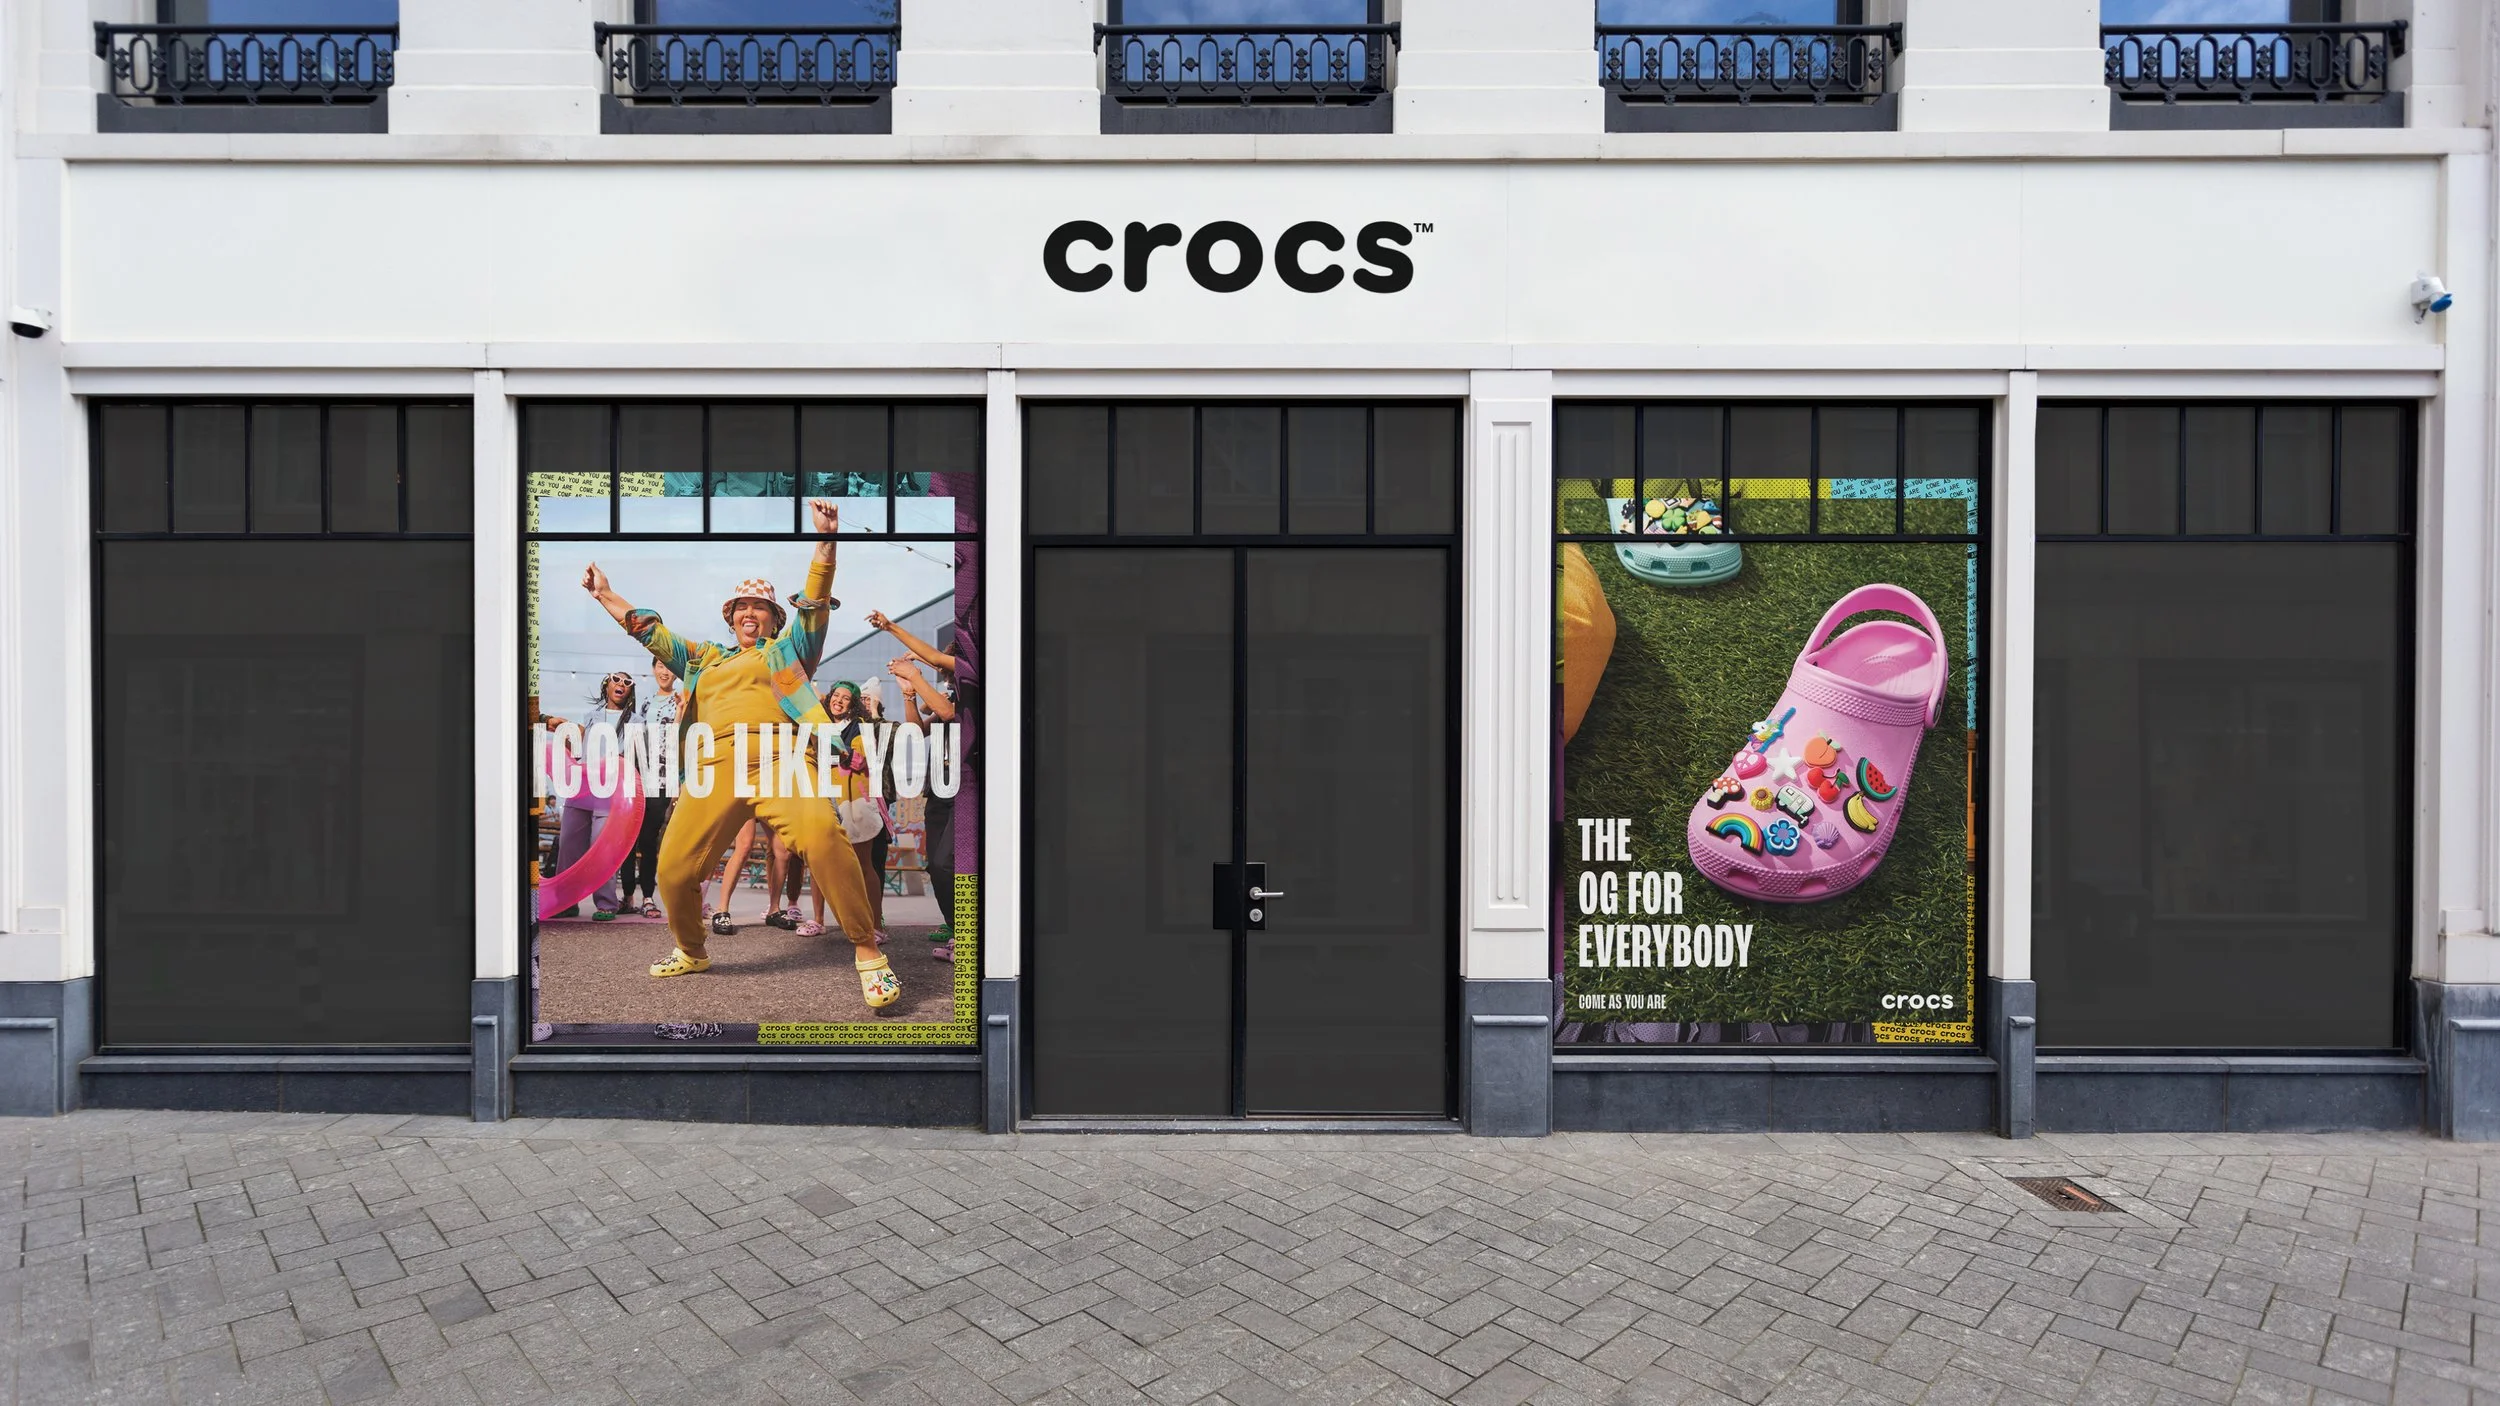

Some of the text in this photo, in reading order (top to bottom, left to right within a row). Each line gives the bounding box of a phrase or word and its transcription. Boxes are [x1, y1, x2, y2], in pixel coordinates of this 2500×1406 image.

[1043, 220, 1413, 293] crocs
[533, 722, 961, 798] ICONIC LIKE YOU
[1578, 818, 1632, 861] THE
[1579, 871, 1683, 914] OG FOR
[1579, 924, 1753, 968] EVERYBODY
[1579, 994, 1667, 1010] COME AS YOU ARE
[1882, 994, 1954, 1009] crocs
